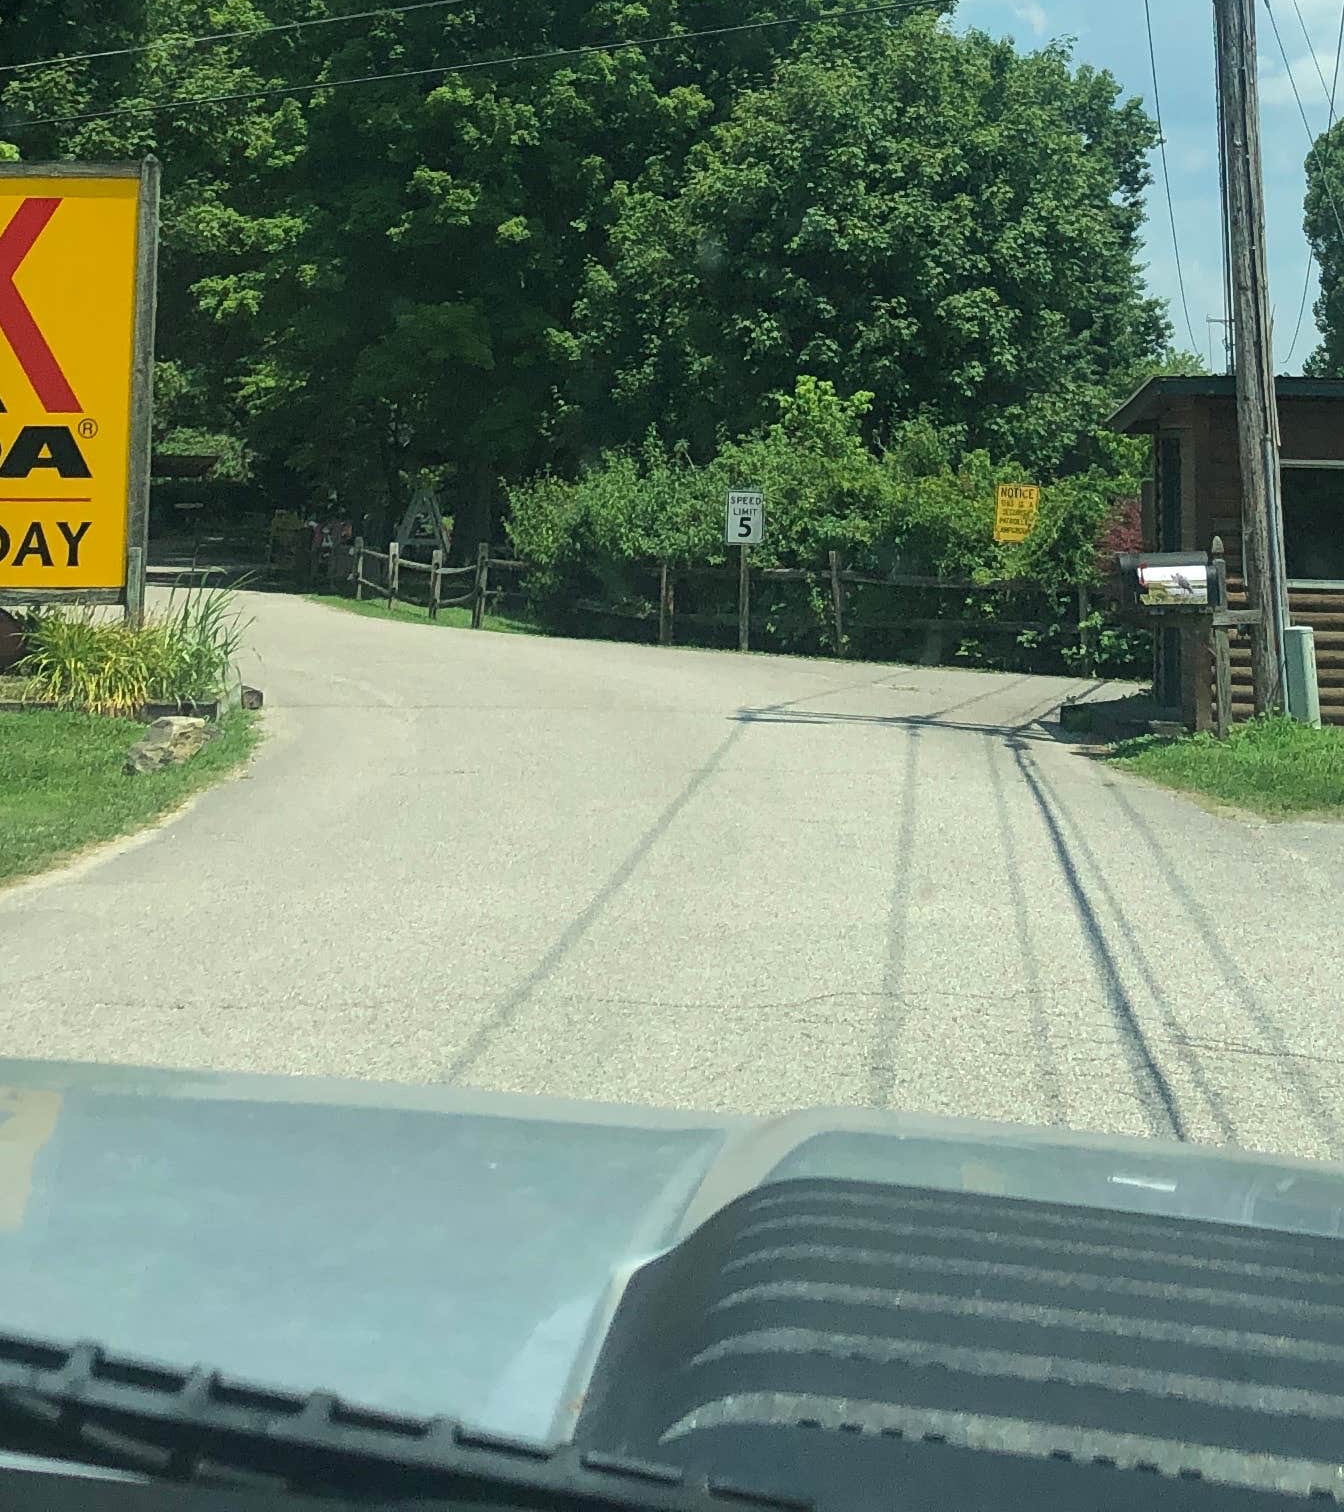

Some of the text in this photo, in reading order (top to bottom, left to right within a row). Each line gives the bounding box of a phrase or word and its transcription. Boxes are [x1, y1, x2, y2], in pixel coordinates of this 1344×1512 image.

[1000, 487, 1034, 500] NOTICE
[730, 496, 762, 506] SPEED
[733, 508, 760, 517] LIMIT
[737, 516, 752, 538] 5
